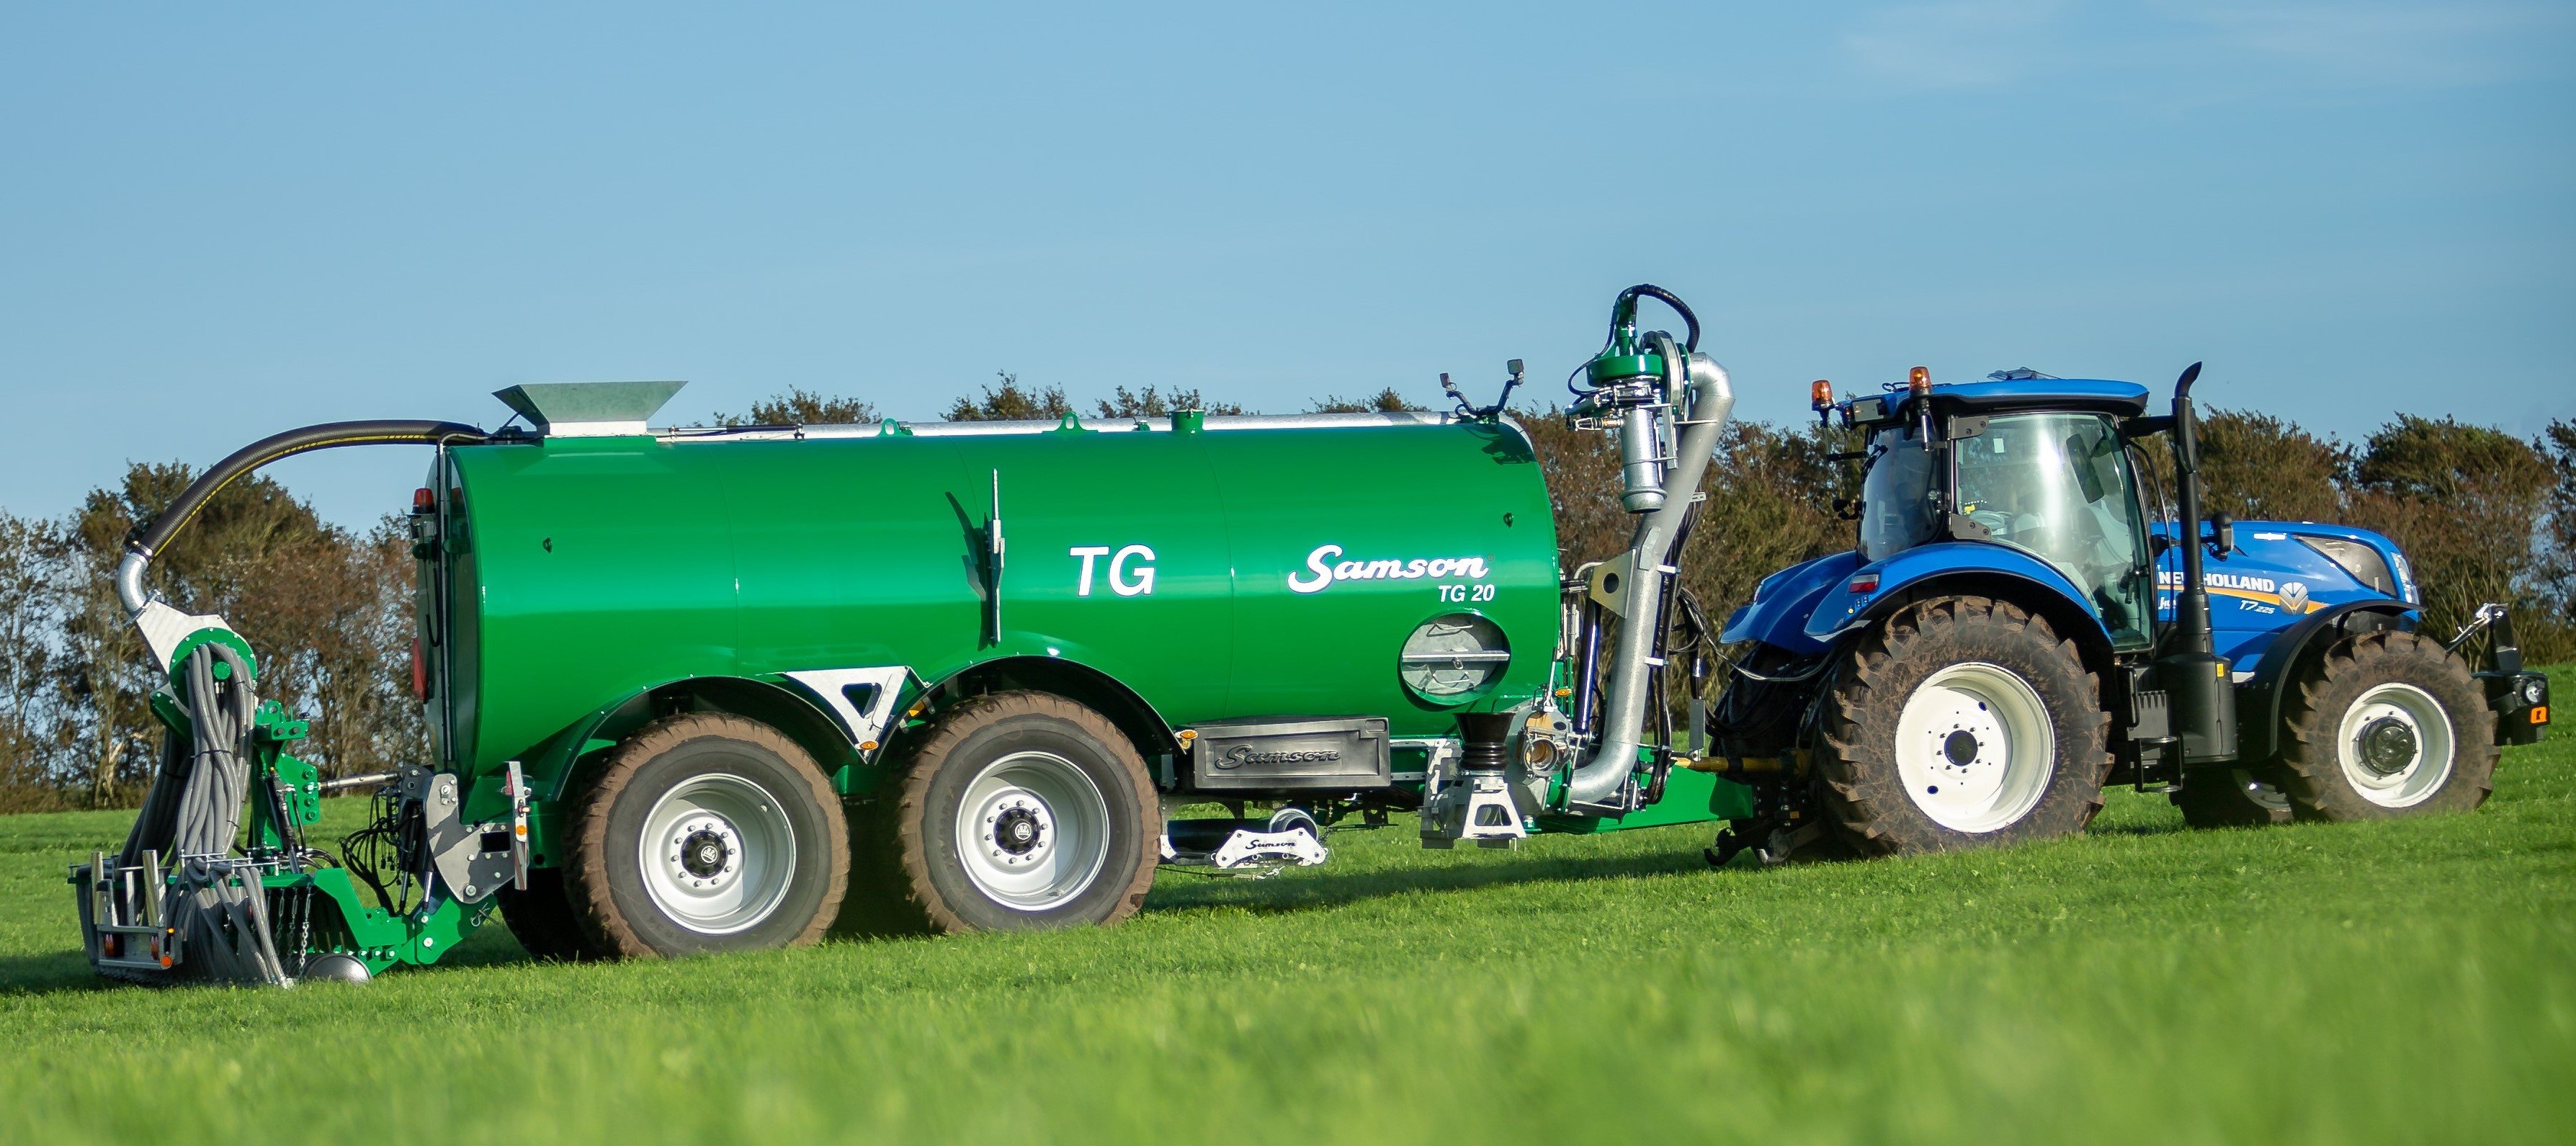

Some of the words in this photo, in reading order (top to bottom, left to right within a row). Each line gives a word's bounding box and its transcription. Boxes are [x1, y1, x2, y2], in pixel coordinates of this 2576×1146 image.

[1070, 544, 1156, 596] TG
[1287, 544, 1489, 594] Samson
[1438, 584, 1467, 603] TG
[1470, 583, 1495, 602] 20
[2157, 571, 2184, 585] NE
[2203, 573, 2275, 593] HOLLAND
[1215, 744, 1341, 771] Samson
[1245, 839, 1296, 850] Samson
